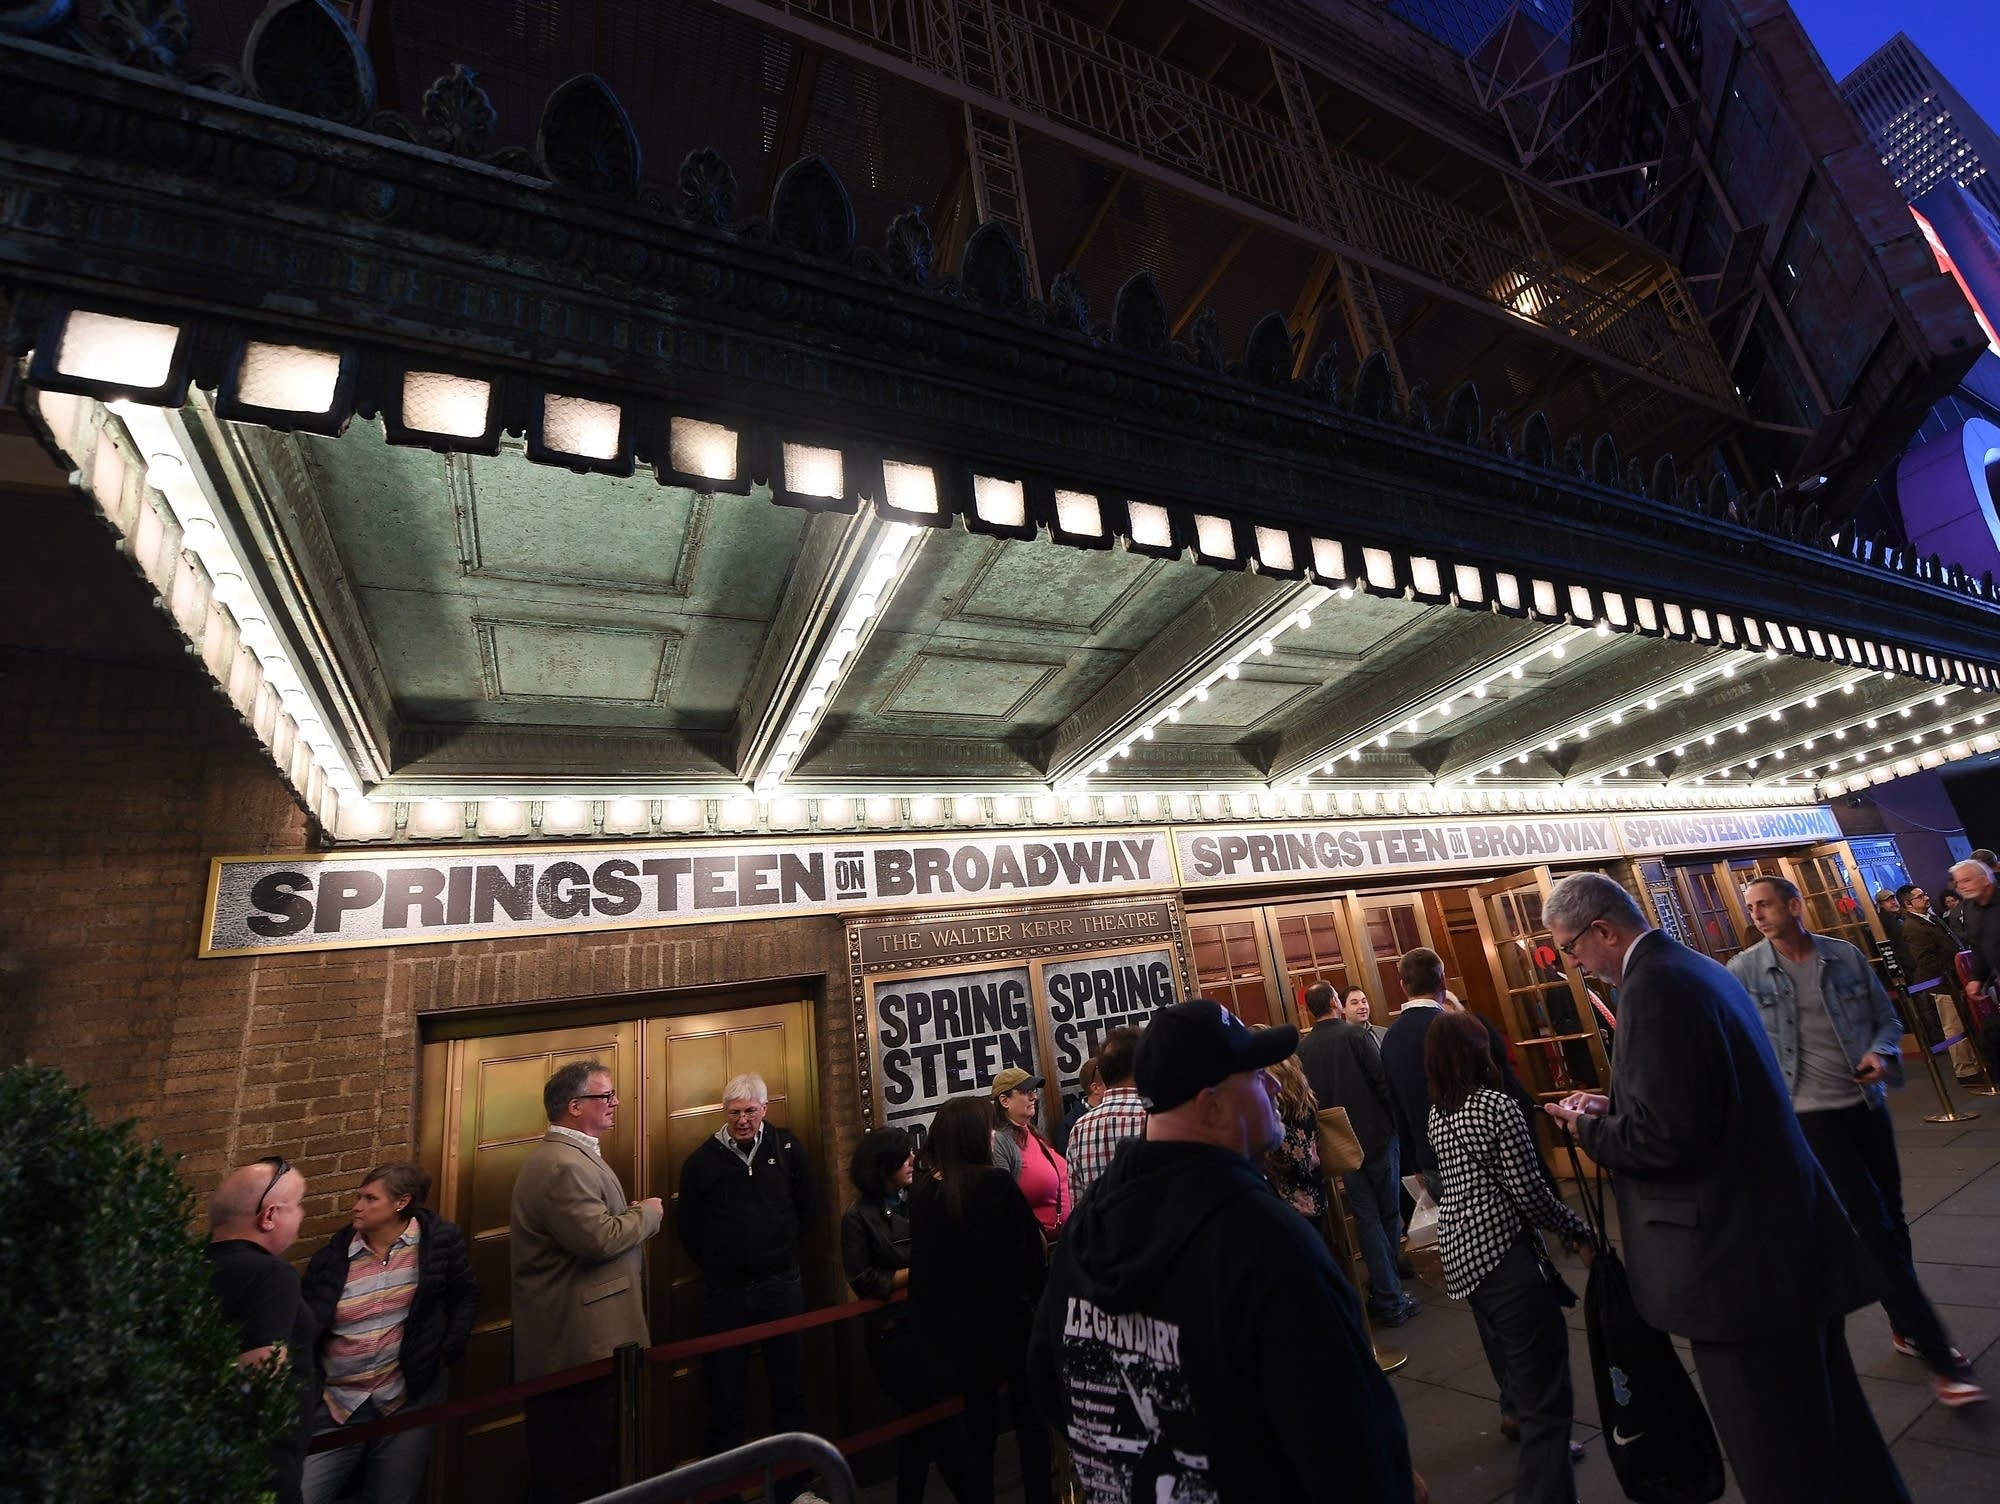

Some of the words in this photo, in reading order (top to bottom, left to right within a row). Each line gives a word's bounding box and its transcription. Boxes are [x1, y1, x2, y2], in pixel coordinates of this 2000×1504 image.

[1191, 828, 1449, 877] SPRINGSTEEN
[1449, 832, 1467, 855] ON
[1465, 821, 1609, 858] BROADWAY
[1623, 815, 1750, 849] SPRINGSTEEN
[247, 853, 827, 938] SPRINGSTEEN
[834, 859, 866, 891] ON
[874, 839, 1155, 897] BROADWAY
[876, 932, 922, 953] THE
[930, 924, 1012, 948] WALTER
[1021, 919, 1074, 939] KERR
[1080, 911, 1160, 934] THEATRE
[879, 980, 1029, 1049] SPRING
[1049, 961, 1174, 1023] SPRING
[883, 1030, 1035, 1105] STEEN
[1063, 1297, 1180, 1367] LEGENDARY
